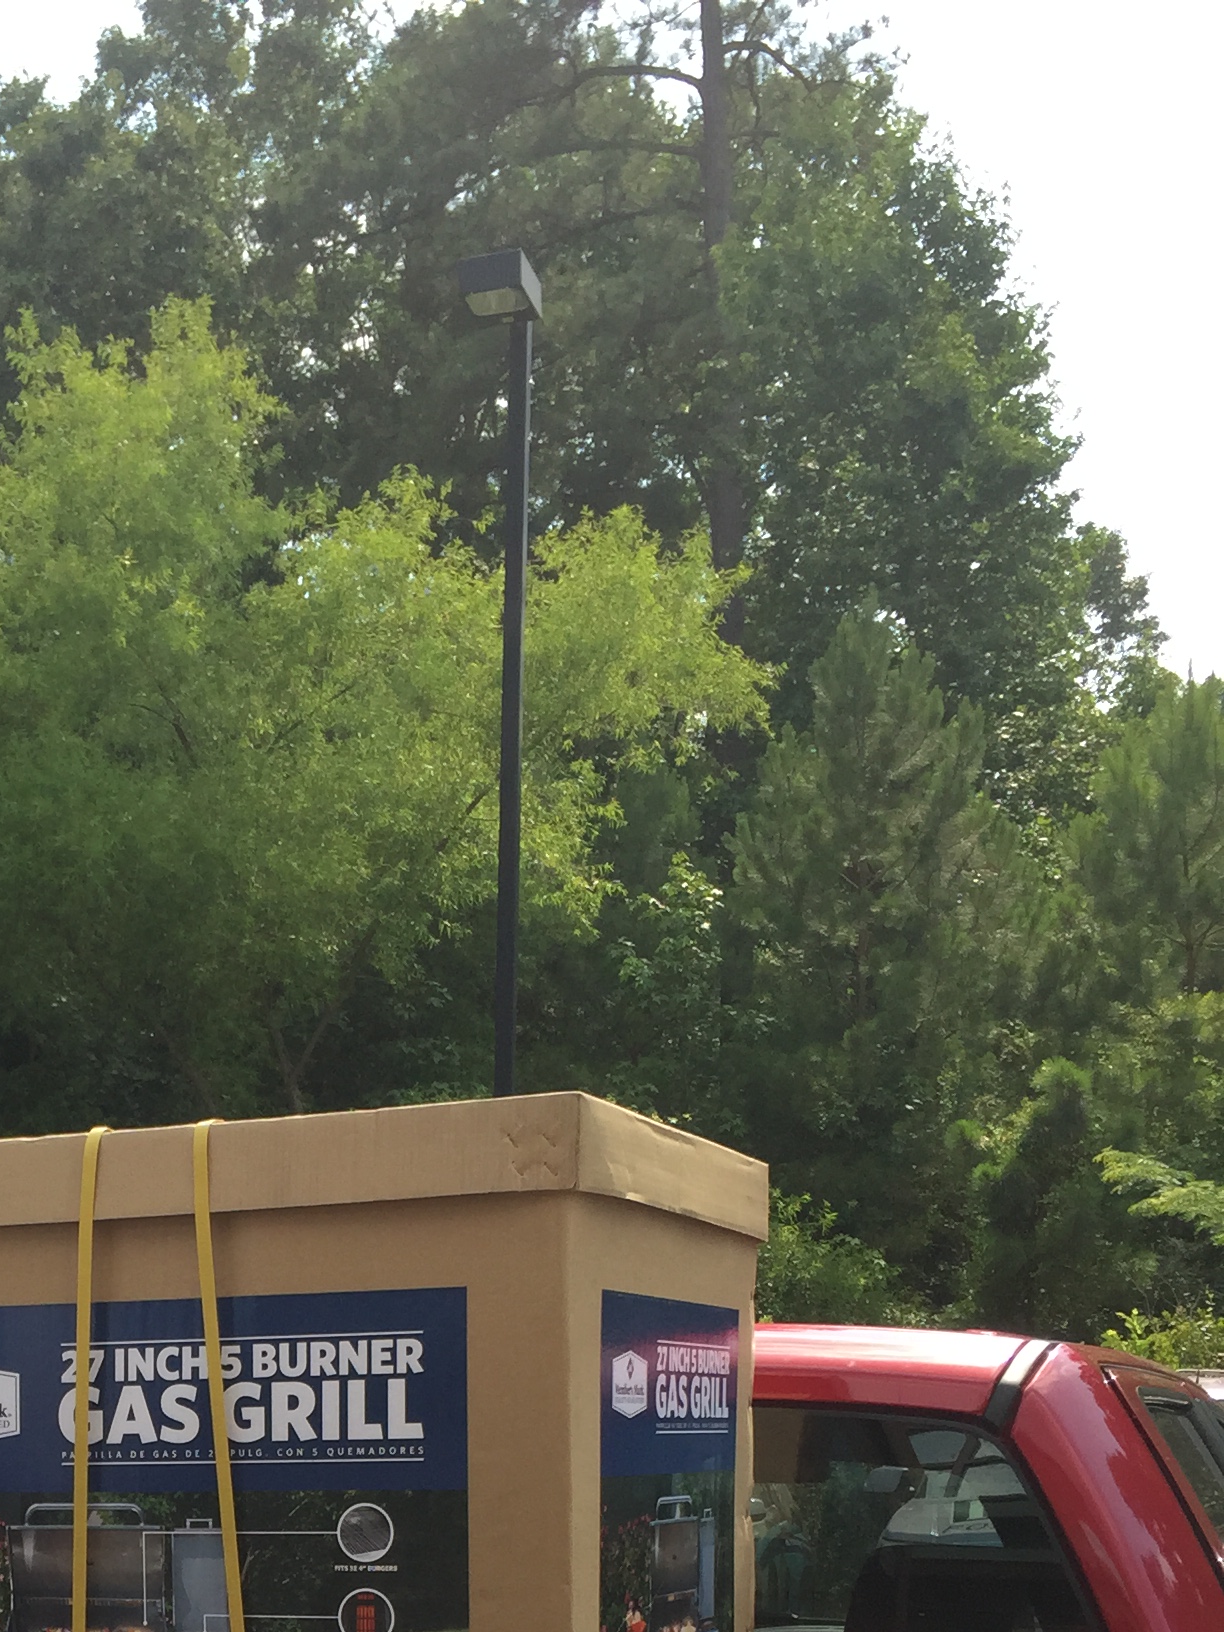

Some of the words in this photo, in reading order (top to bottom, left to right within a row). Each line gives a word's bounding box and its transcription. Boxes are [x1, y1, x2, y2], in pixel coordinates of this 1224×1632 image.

[61, 1350, 104, 1383] 27
[115, 1346, 209, 1382] INCH
[220, 1345, 242, 1379] 5
[253, 1338, 424, 1378] BURNER
[656, 1346, 668, 1371] 27
[669, 1346, 690, 1372] INCH
[691, 1349, 697, 1373] 5
[698, 1349, 730, 1375] BURNER
[58, 1383, 200, 1445] GAS
[223, 1378, 425, 1444] GRILL
[656, 1373, 688, 1418] GAS
[690, 1375, 729, 1418] GRILL
[61, 1451, 123, 1459] PAILLA
[130, 1450, 145, 1459] DE
[153, 1450, 177, 1459] GAS
[185, 1449, 200, 1458] DE
[276, 1447, 304, 1457] CON
[311, 1447, 319, 1456] 5
[326, 1446, 425, 1458] QUEMADORES
